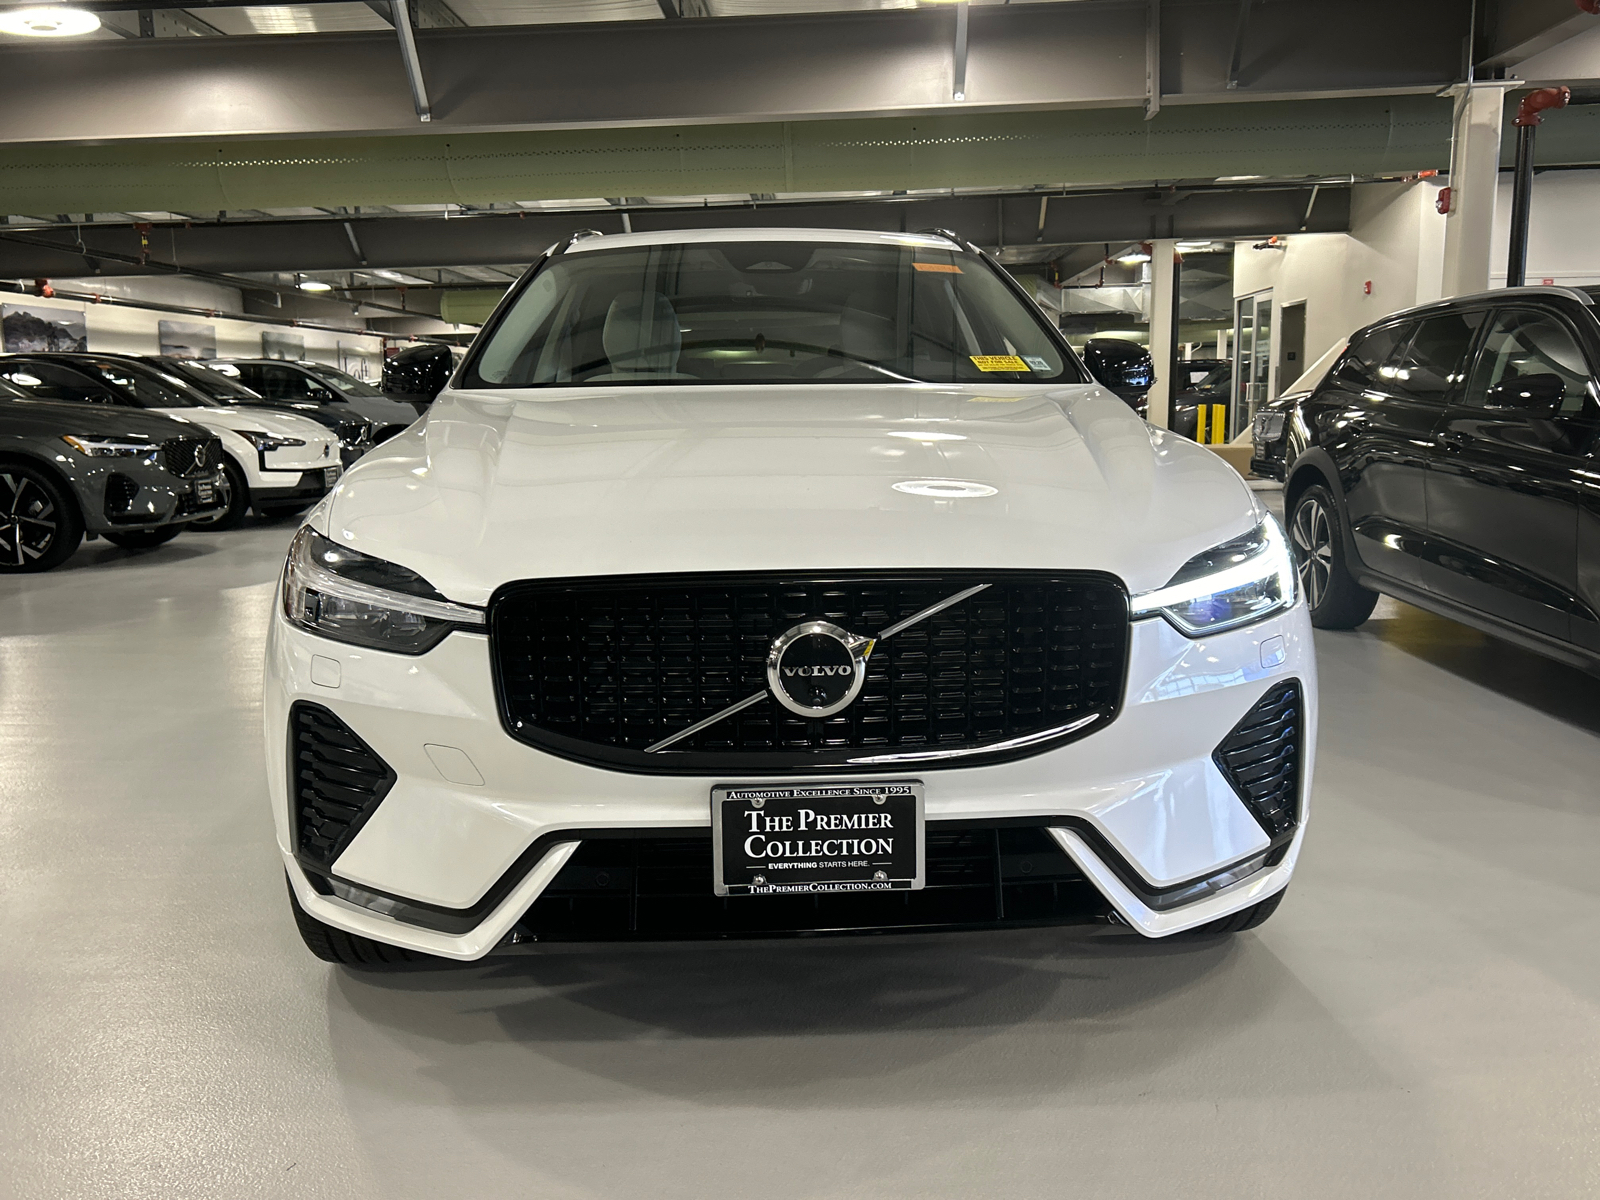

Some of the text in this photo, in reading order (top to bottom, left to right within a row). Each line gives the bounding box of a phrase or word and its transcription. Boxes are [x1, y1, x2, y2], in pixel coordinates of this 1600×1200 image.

[782, 665, 852, 677] VOLVO
[884, 786, 910, 794] 1995
[768, 862, 817, 870] EVERYTHING
